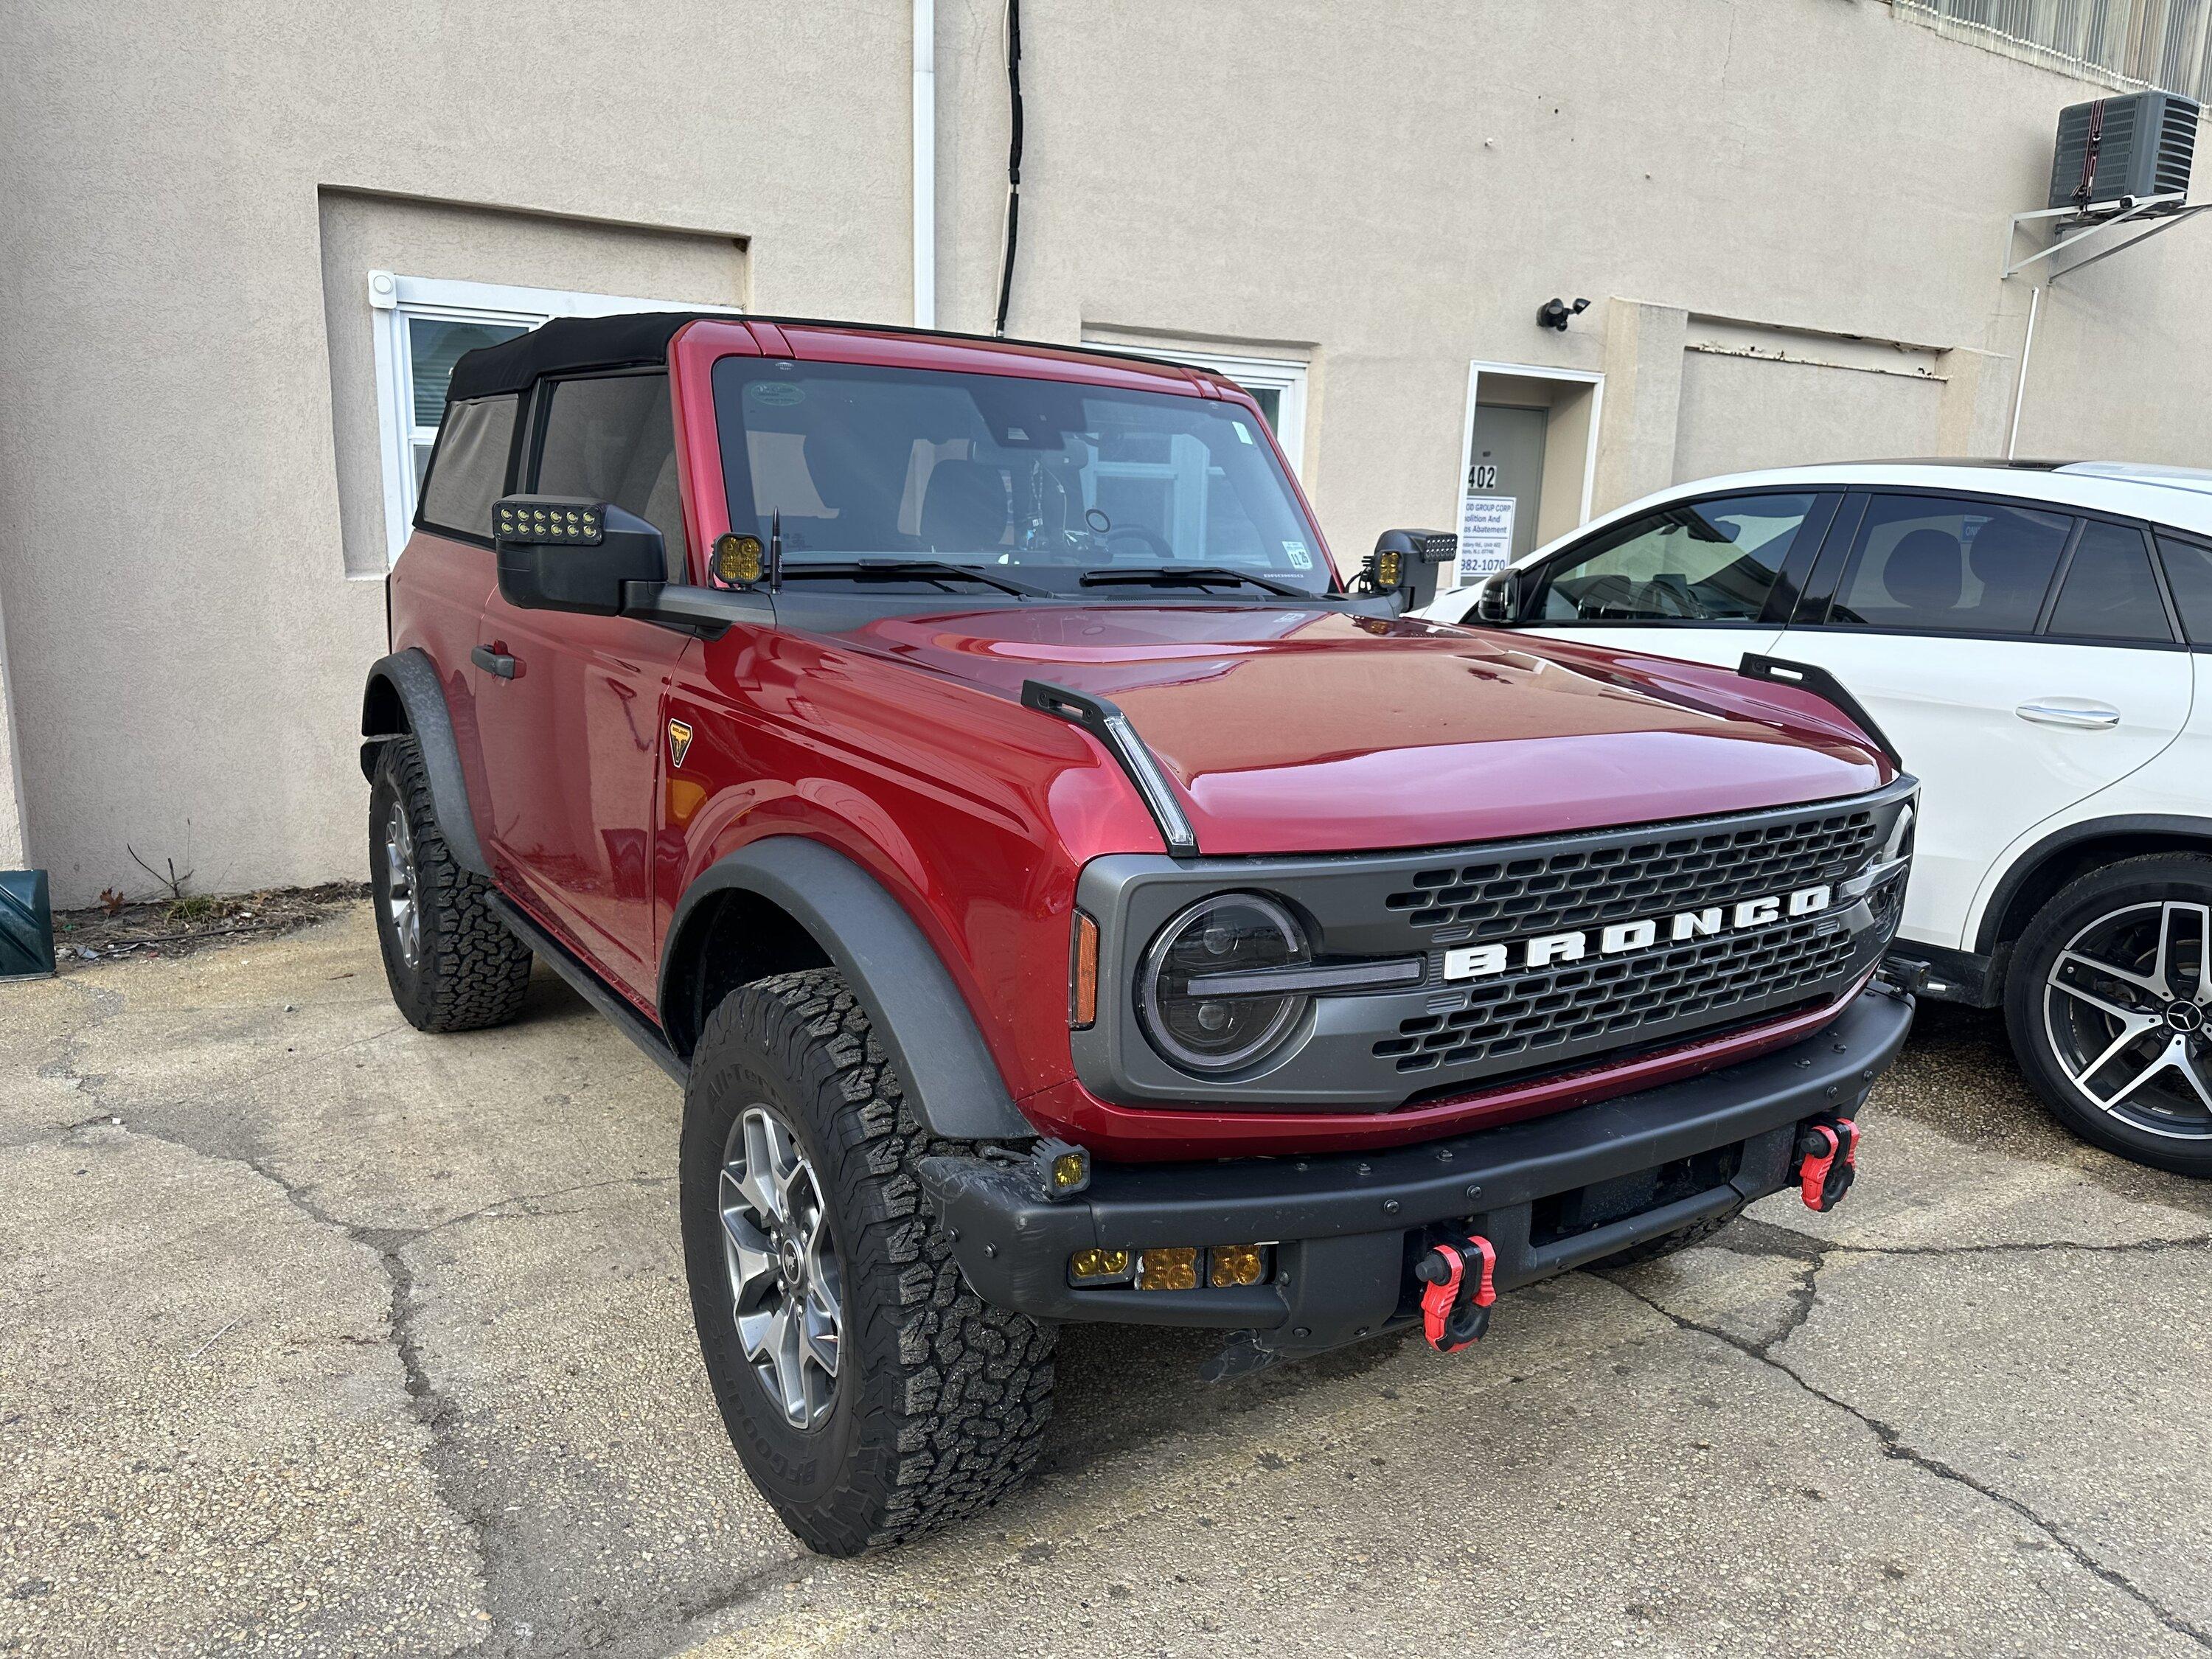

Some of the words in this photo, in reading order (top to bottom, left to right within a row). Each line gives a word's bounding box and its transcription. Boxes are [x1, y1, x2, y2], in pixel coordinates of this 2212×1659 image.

[1468, 466, 1495, 488] 402
[1475, 504, 1495, 512] GROUP
[1495, 504, 1512, 512] CORP
[1472, 525, 1507, 534] Abatement
[1461, 559, 1506, 571] 982-1070
[1444, 885, 1831, 980] BRONCO
